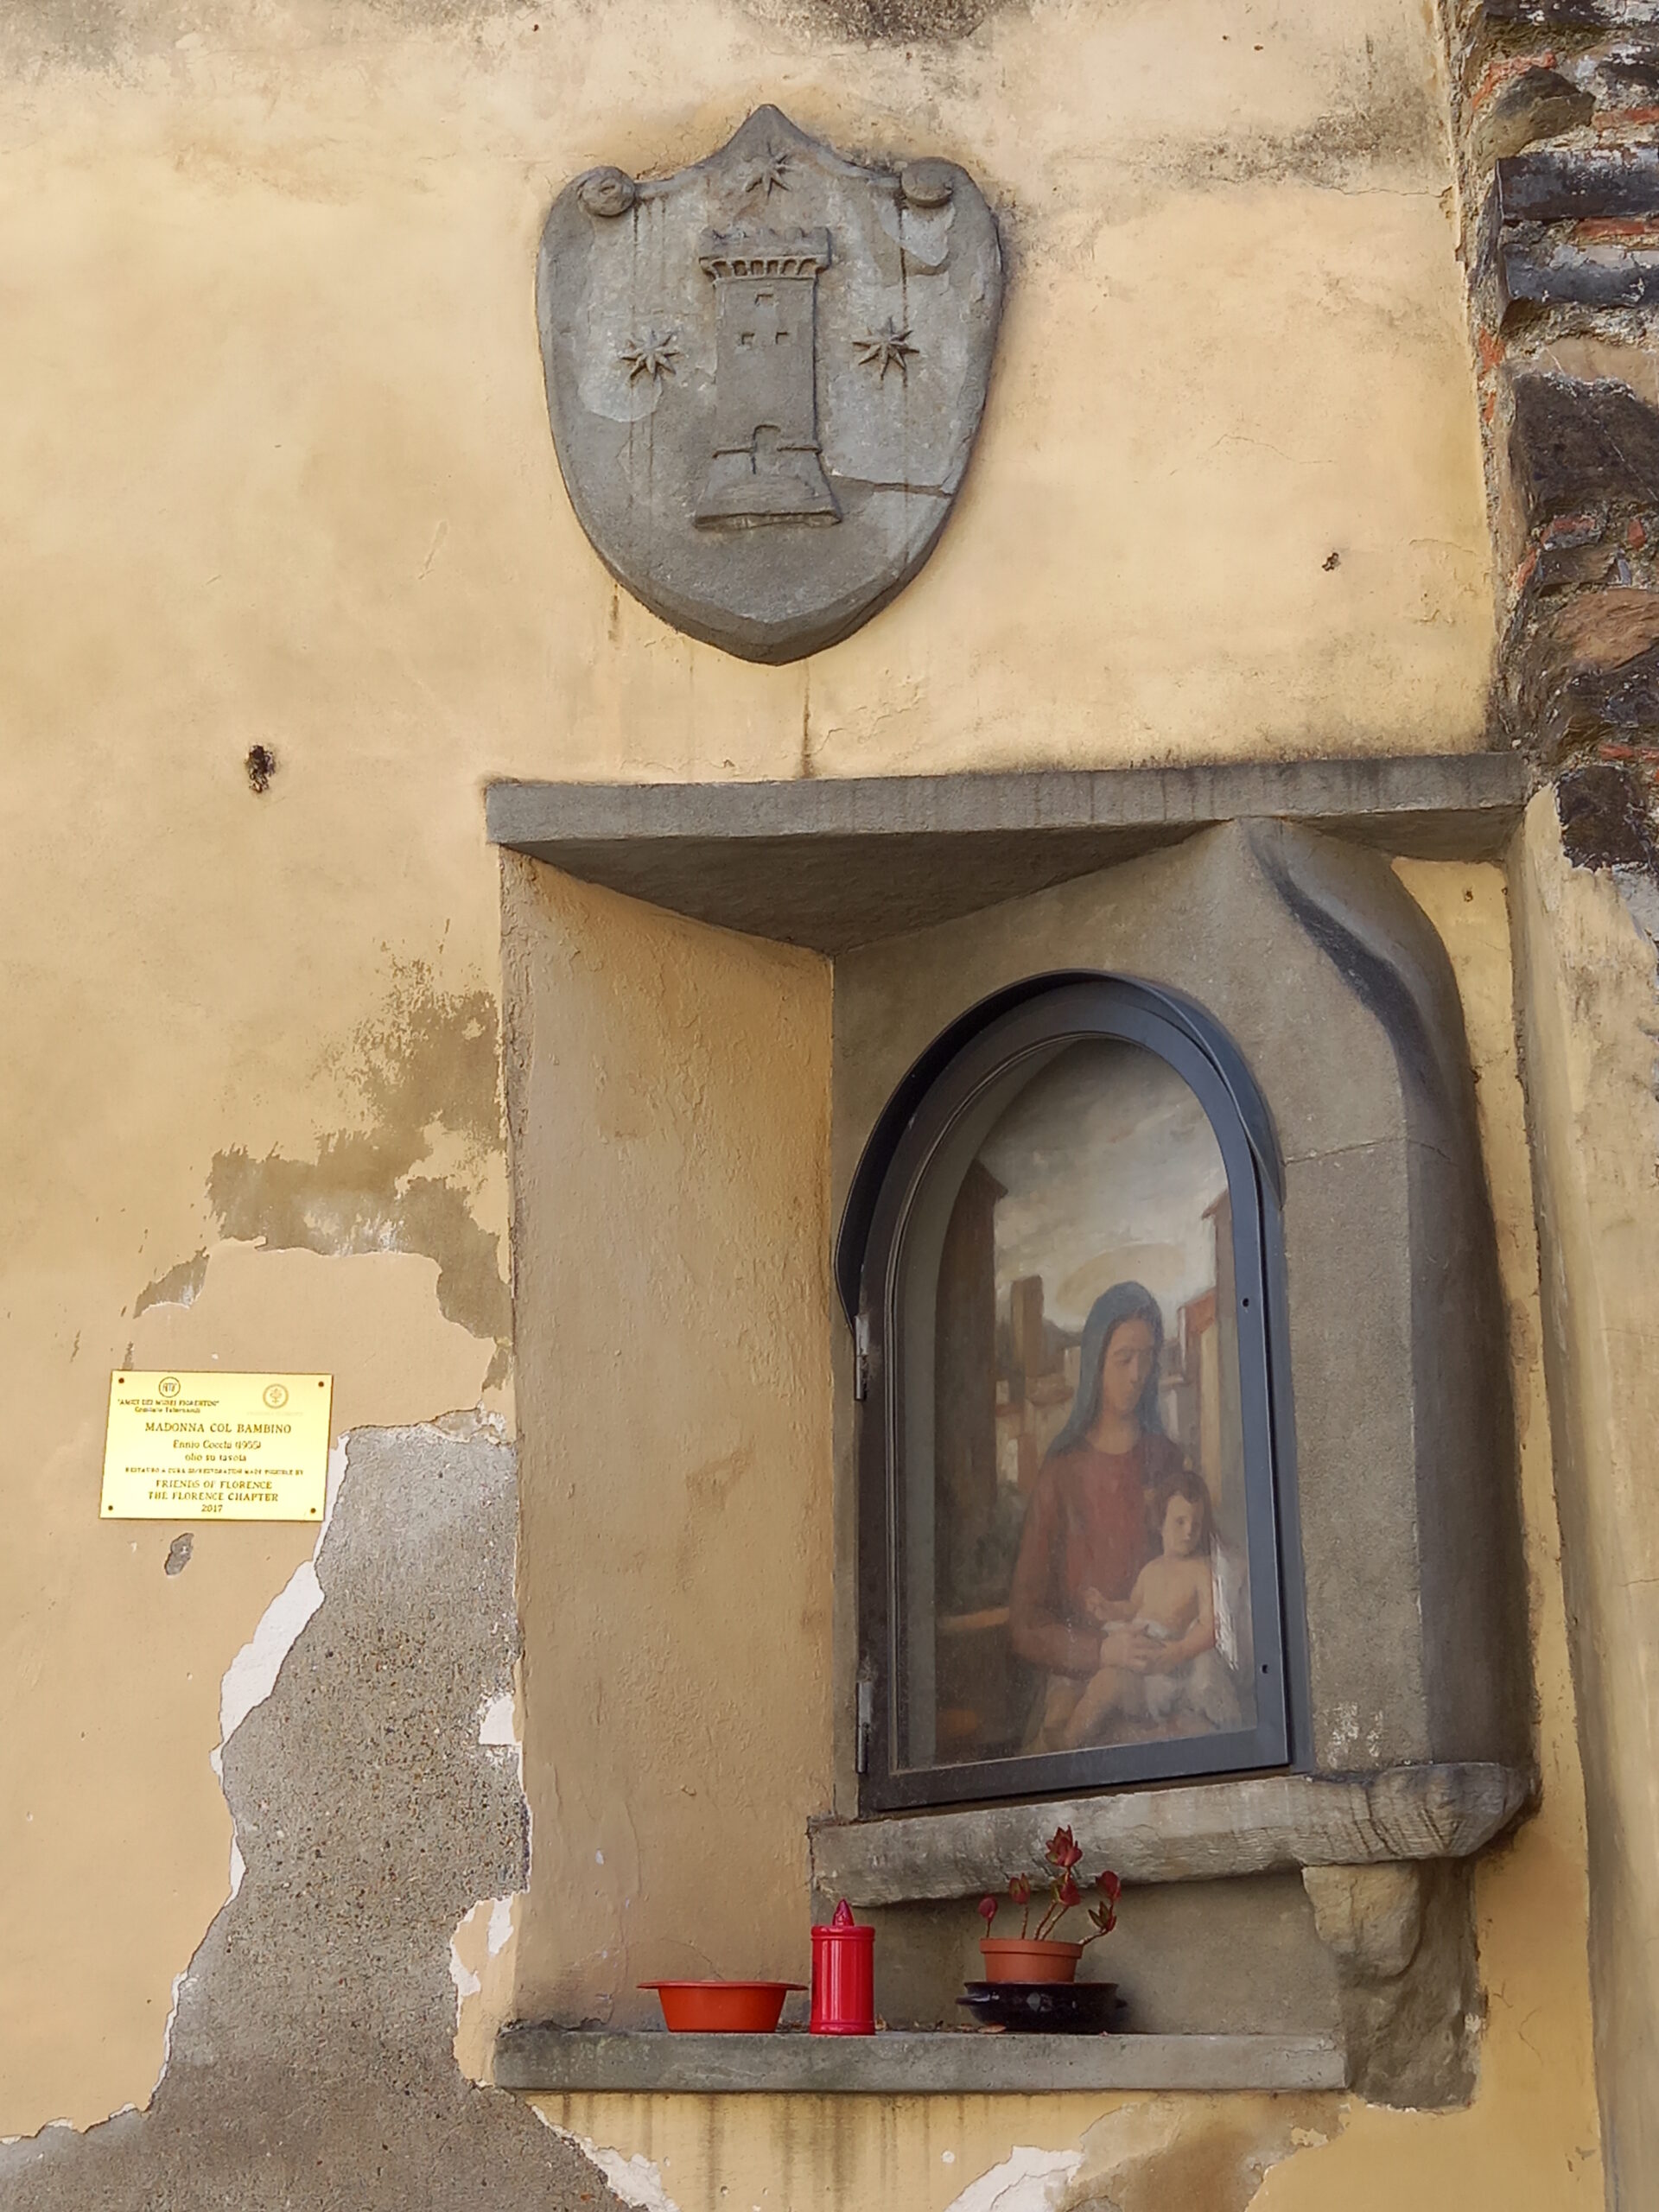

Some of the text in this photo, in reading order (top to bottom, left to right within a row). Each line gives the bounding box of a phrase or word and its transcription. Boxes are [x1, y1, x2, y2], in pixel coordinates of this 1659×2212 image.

[145, 1421, 292, 1433] MADONNA COL BAMBINO
[173, 1439, 200, 1449] Ennio
[184, 1452, 203, 1461] olio
[156, 1479, 200, 1488] FRIENDS
[220, 1480, 273, 1489] FLORENCE
[149, 1491, 279, 1502] THE FLORENCE CHAPTER
[201, 1503, 223, 1513] 2017
